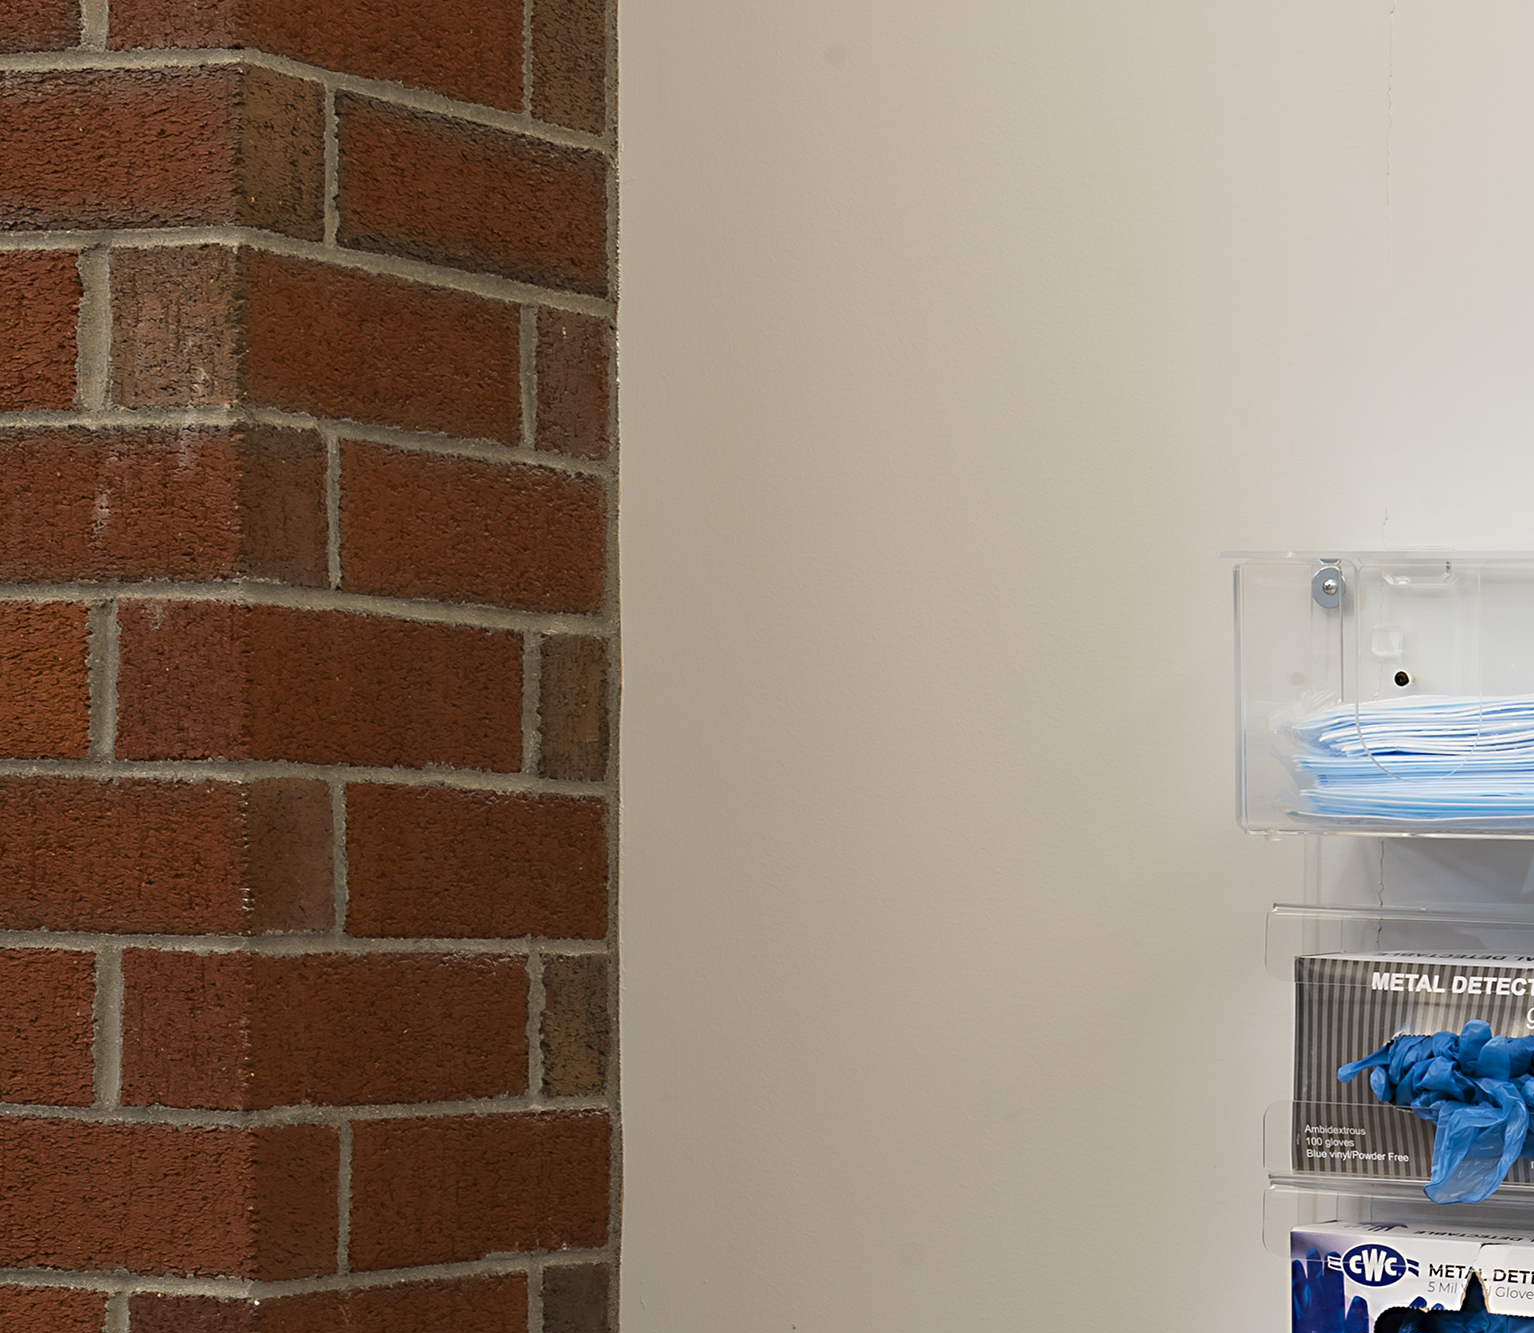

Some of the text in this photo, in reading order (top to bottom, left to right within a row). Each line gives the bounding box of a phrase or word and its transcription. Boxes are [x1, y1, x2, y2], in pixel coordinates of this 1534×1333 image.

[1371, 972, 1446, 993] METAL
[1304, 1124, 1367, 1136] Ambidextrous
[1306, 1137, 1355, 1149] 100 gloves
[1306, 1148, 1410, 1162] Blue vinyl/Powder Free
[1427, 1281, 1436, 1292] 5
[1438, 1282, 1457, 1293] Mil
